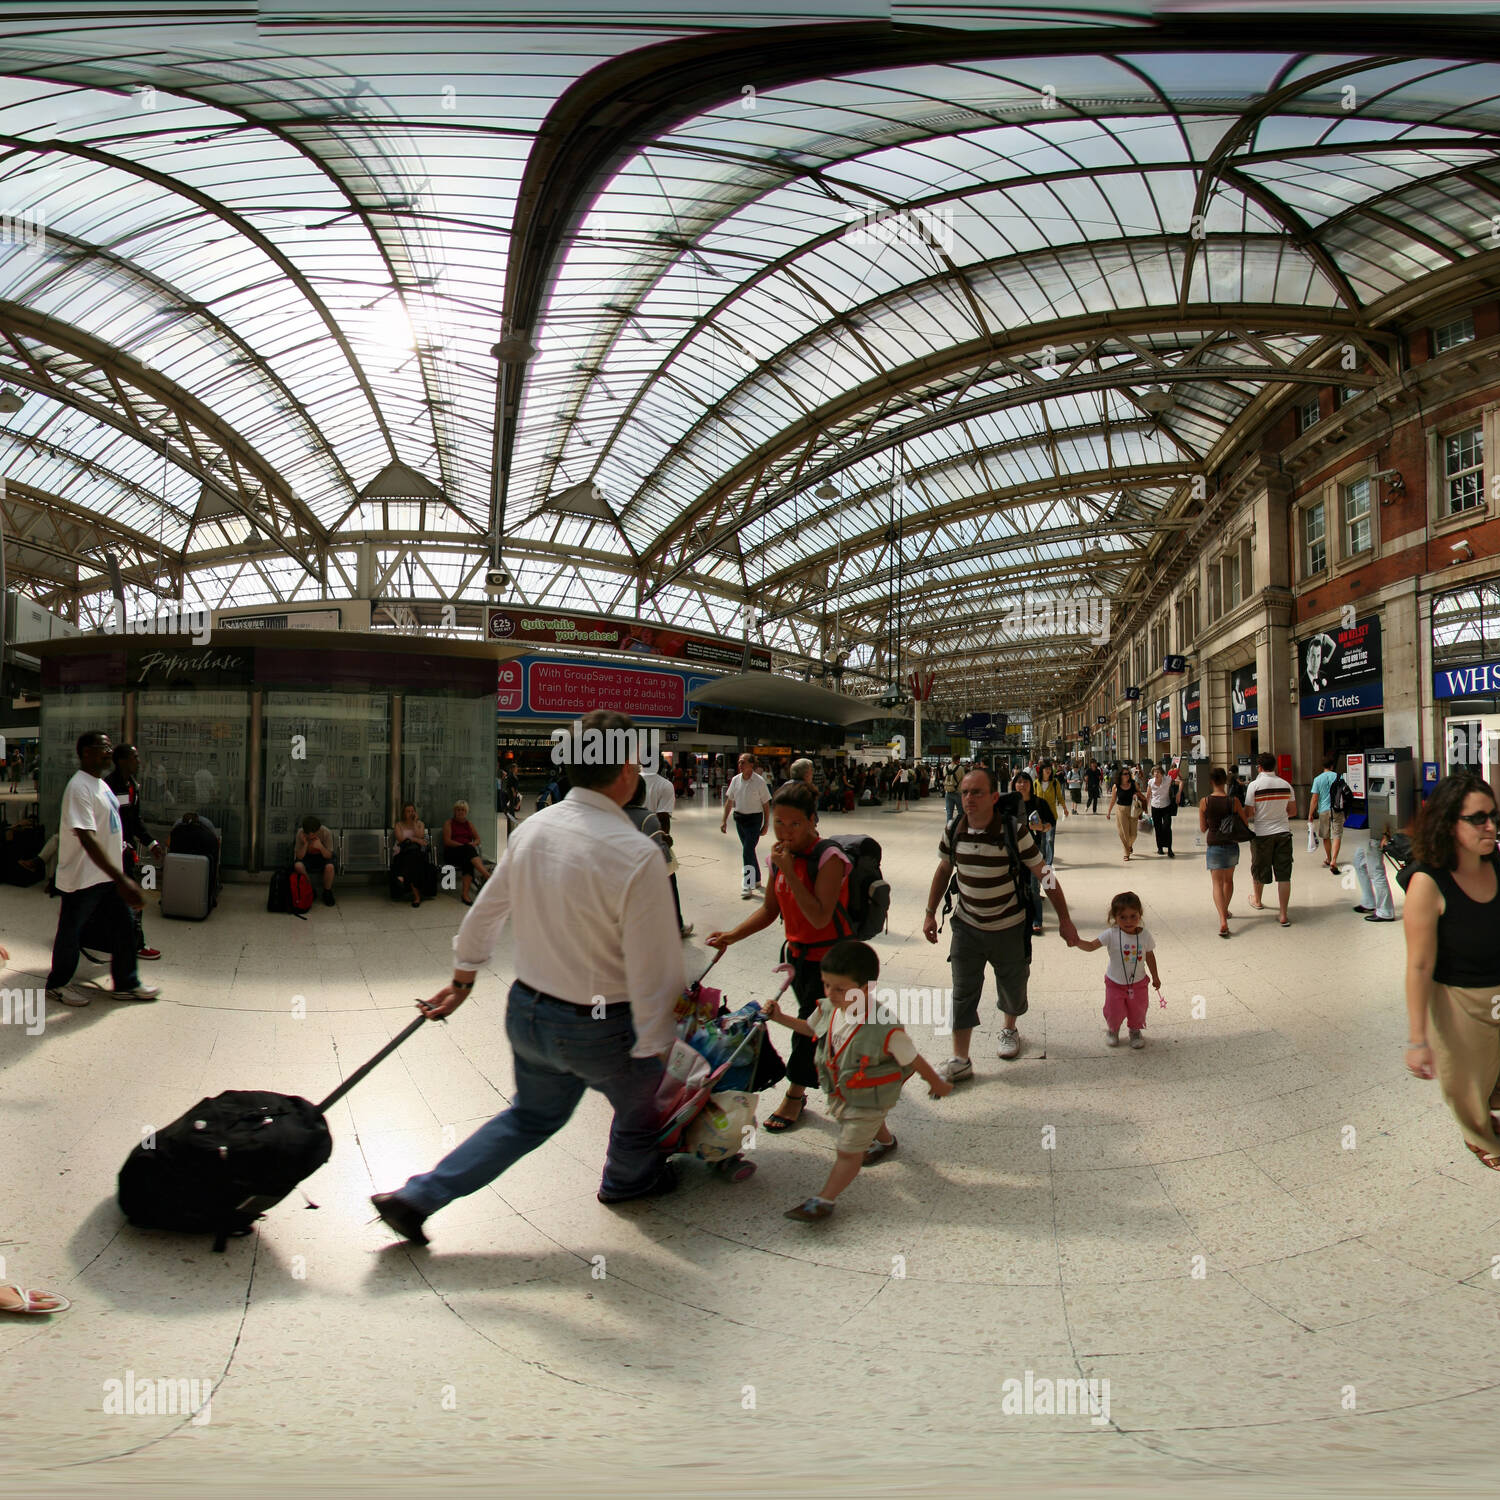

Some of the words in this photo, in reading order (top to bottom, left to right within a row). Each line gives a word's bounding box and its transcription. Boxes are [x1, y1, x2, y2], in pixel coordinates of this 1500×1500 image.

[494, 619, 511, 628] £25
[521, 619, 545, 631] Quit
[546, 620, 575, 630] while
[555, 630, 588, 642] you're
[589, 631, 618, 642] ahead
[137, 650, 244, 683] Paperchase
[538, 667, 561, 678] With
[564, 669, 614, 682] GroupSave
[616, 674, 622, 684] 3
[636, 676, 641, 685] 4
[669, 678, 678, 690] by
[538, 682, 562, 693] train
[564, 684, 577, 694] for
[581, 684, 596, 694] the
[598, 686, 620, 698] price
[624, 688, 632, 697] of
[634, 689, 639, 698] 2
[642, 689, 665, 700] adults
[538, 696, 584, 708] hundreds
[587, 696, 596, 708] of
[599, 700, 622, 712] great
[624, 701, 674, 712] destinations
[1330, 694, 1360, 708] Tickets
